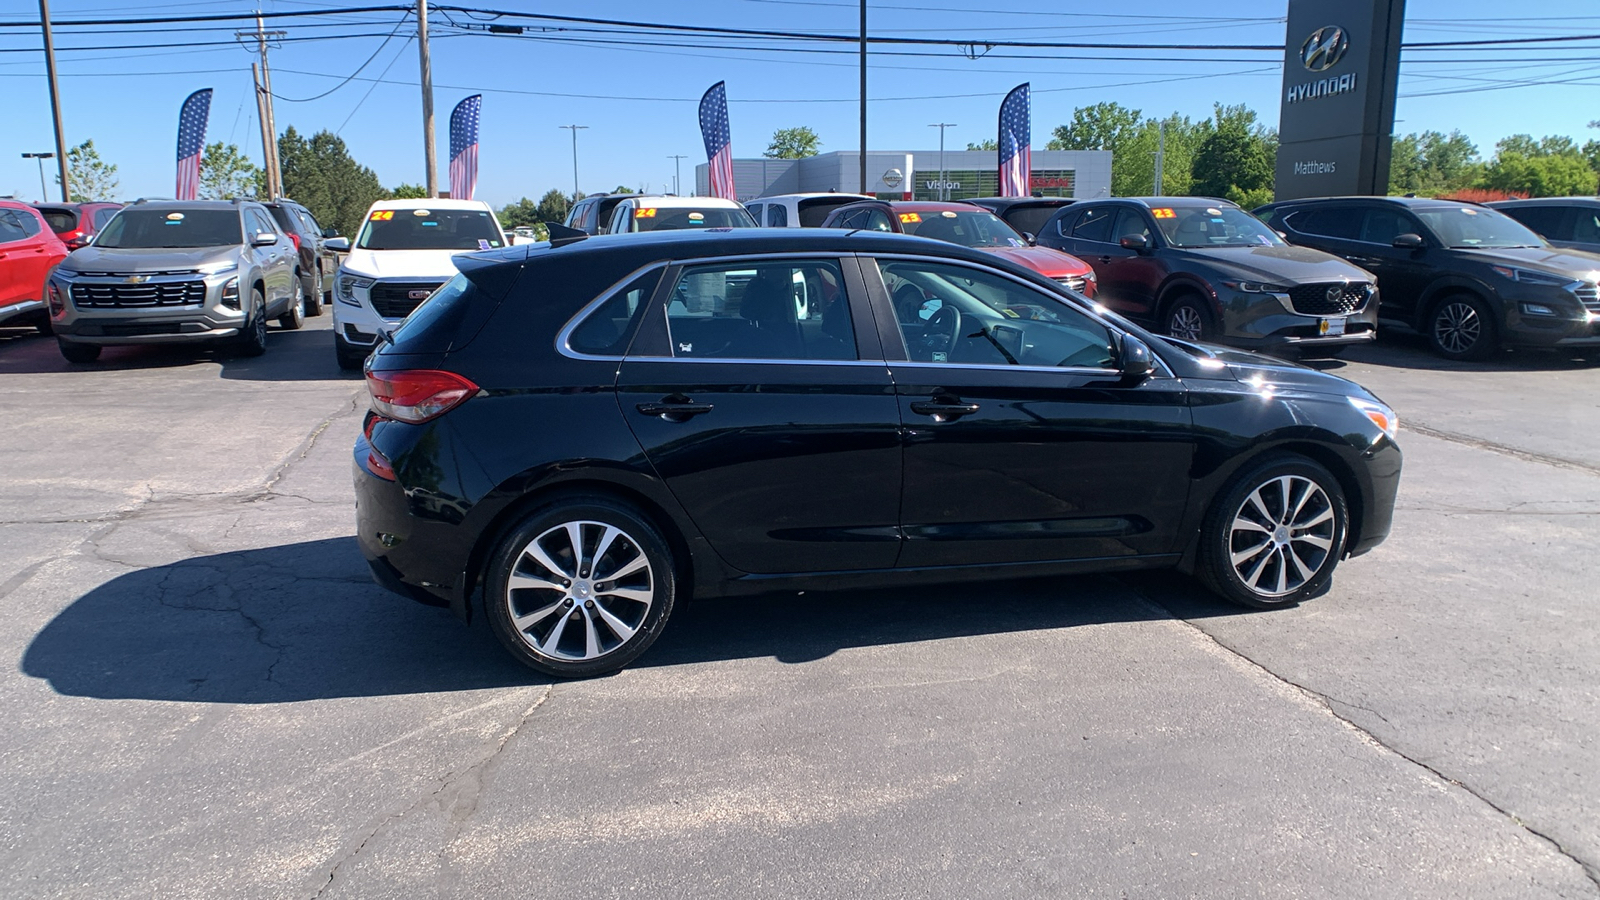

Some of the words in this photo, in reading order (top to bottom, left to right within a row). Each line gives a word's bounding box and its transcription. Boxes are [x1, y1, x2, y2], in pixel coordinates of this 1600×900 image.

[1287, 72, 1357, 103] HYUNDAI
[1294, 160, 1336, 175] Matthews
[926, 179, 961, 190] Vision
[1031, 177, 1069, 188] SSAN
[370, 210, 394, 221] 24
[635, 208, 656, 218] 24
[899, 213, 919, 223] 23
[1152, 208, 1173, 218] 23
[408, 290, 431, 299] GM
